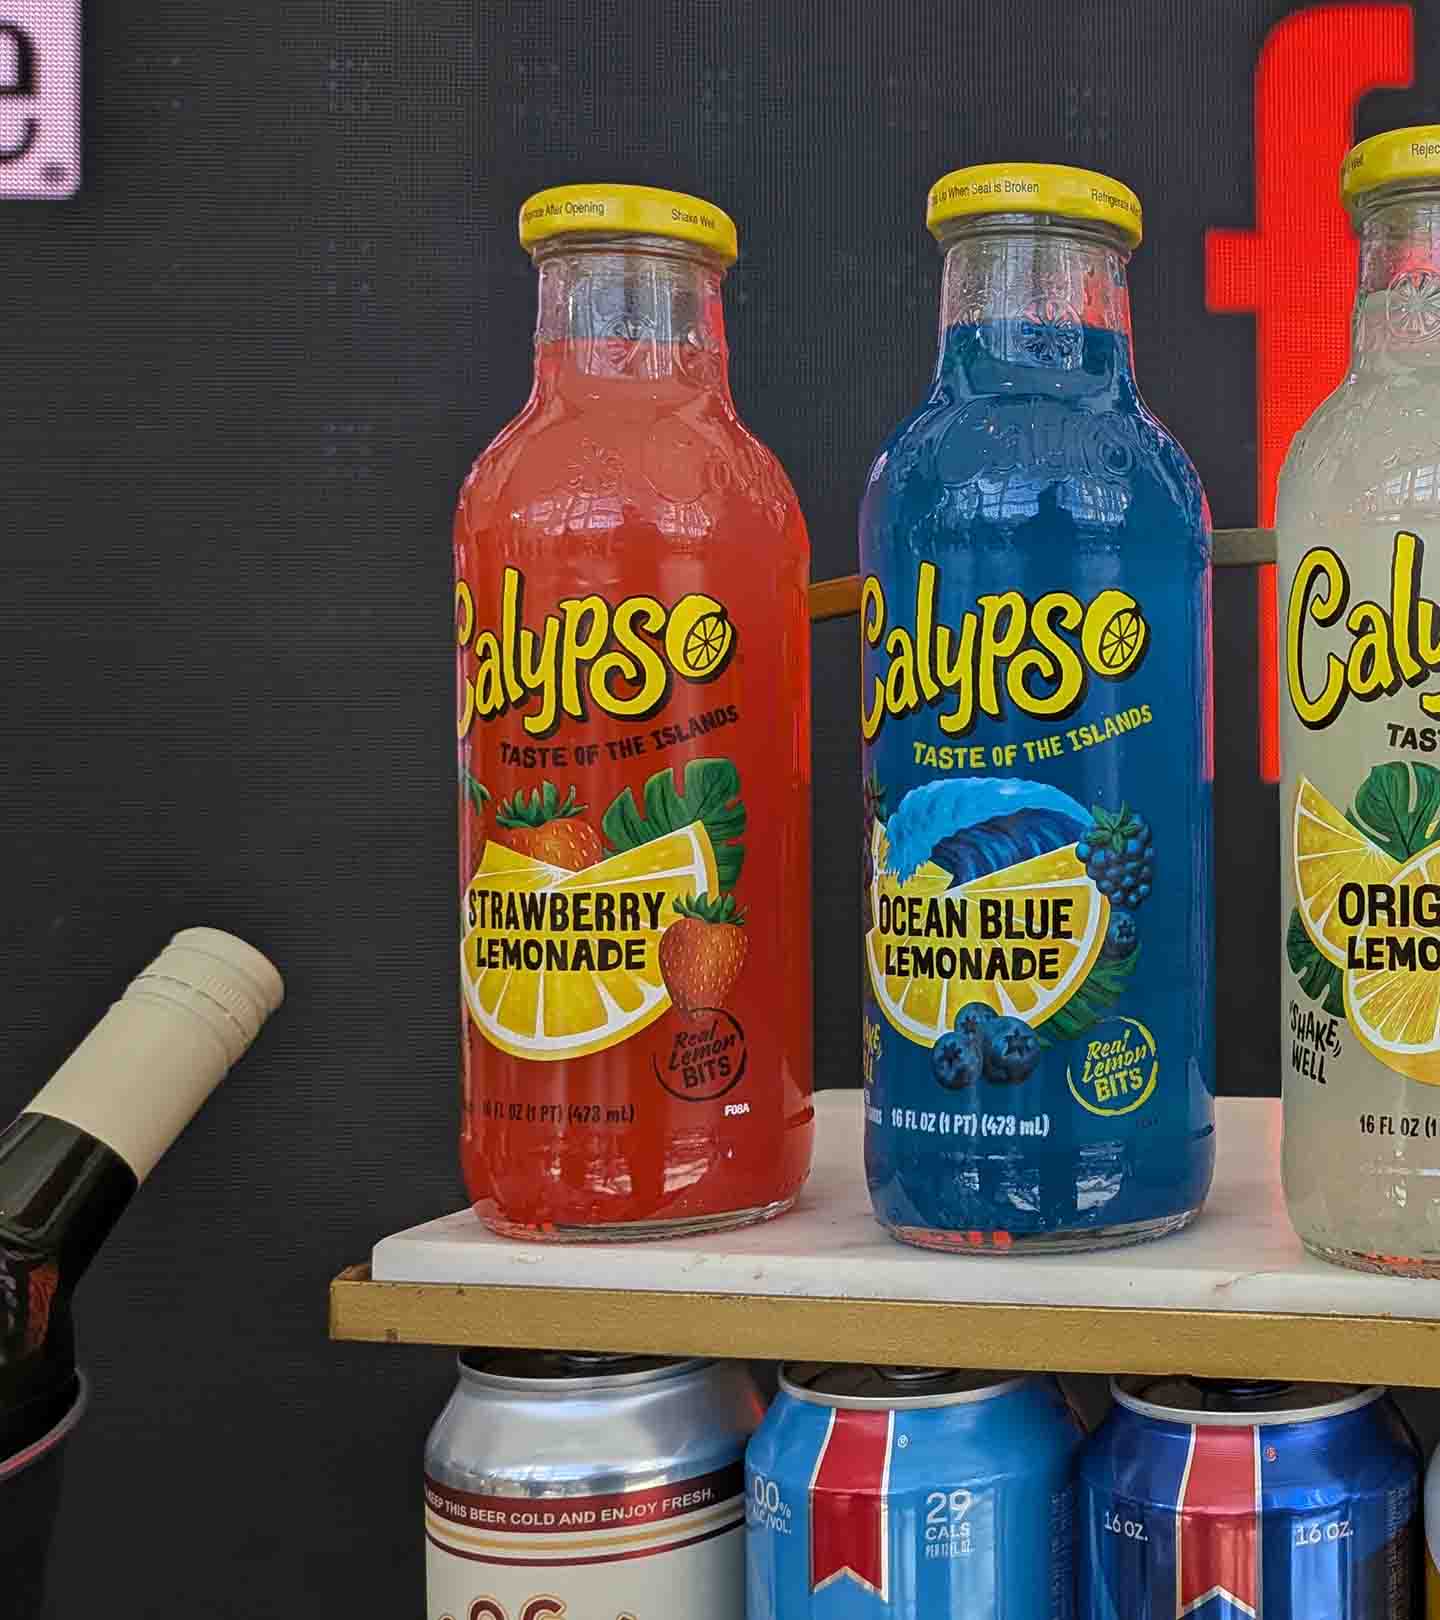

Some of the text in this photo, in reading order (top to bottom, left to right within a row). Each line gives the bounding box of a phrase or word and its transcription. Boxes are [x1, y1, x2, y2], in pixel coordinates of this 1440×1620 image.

[948, 186, 970, 199] When
[971, 183, 992, 195] Seal
[1004, 181, 1040, 193] Broken
[564, 201, 605, 216] Opening
[671, 208, 698, 225] Shake
[500, 704, 738, 769] TASTE OF THE ISLANDS
[913, 704, 1153, 769] TASTE OF THE ISLANDS
[468, 889, 666, 932] STRAWBERRY
[879, 893, 1073, 940] OCEAN BLUE
[476, 938, 646, 973] LEMONADE
[885, 944, 1060, 981] LEMONADE
[674, 1019, 718, 1050] Real
[1087, 1029, 1131, 1060] Real
[682, 1055, 732, 1089] BITS
[1082, 1045, 1147, 1084] Lemon
[1291, 1042, 1328, 1085] WELL
[1093, 1068, 1144, 1103] BITS
[725, 1102, 751, 1116] F08A
[891, 1107, 904, 1128] 16
[905, 1110, 919, 1130] FL
[920, 1112, 937, 1133] OZ
[938, 1112, 952, 1135] (1
[953, 1113, 978, 1136] PT)
[981, 1113, 1016, 1137] (473
[1019, 1113, 1050, 1138] mL)
[1360, 1116, 1375, 1135] 16
[1379, 1116, 1396, 1135] FL
[1400, 1117, 1419, 1137] OZ
[1425, 1116, 1437, 1138] (1
[445, 1500, 468, 1518] THIS
[470, 1506, 507, 1525] BEER
[510, 1512, 555, 1526] COLD
[560, 1510, 596, 1526] AND
[600, 1500, 657, 1522] ENJOY
[927, 1488, 973, 1523] 29
[926, 1521, 971, 1541] CALS
[1104, 1511, 1149, 1542] 16 OZ.
[1295, 1519, 1355, 1546] 16 OZ.
